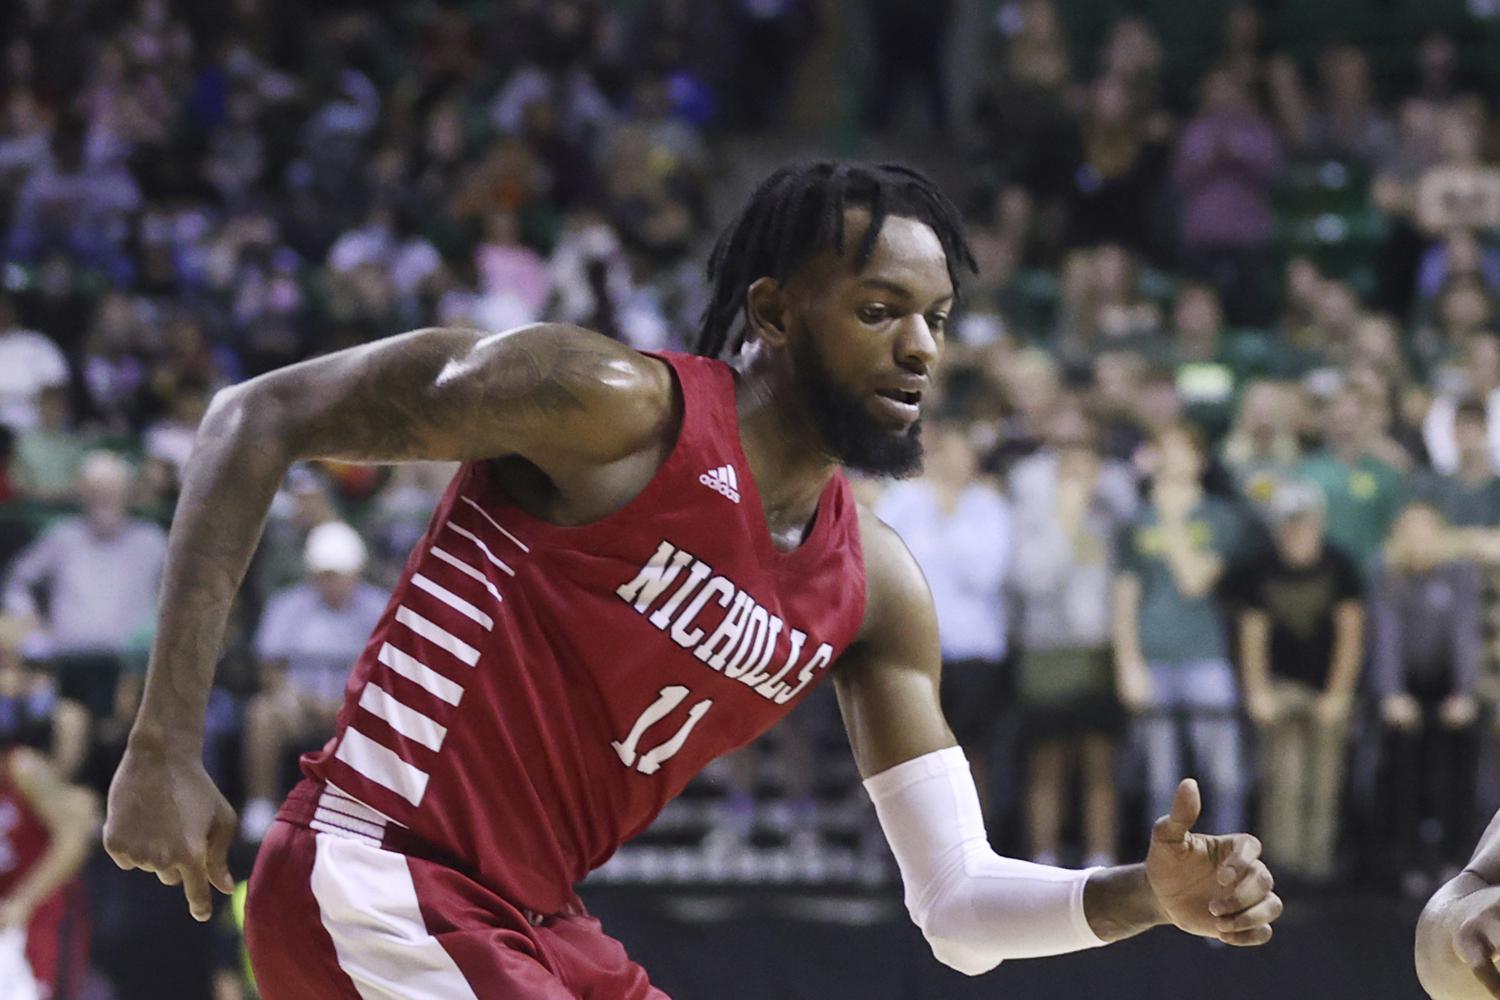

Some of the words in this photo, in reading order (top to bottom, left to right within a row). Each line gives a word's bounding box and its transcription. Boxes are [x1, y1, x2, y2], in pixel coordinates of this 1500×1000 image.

[699, 473, 741, 504] adidas
[616, 539, 834, 706] NICHOLLS
[610, 684, 714, 776] 11
